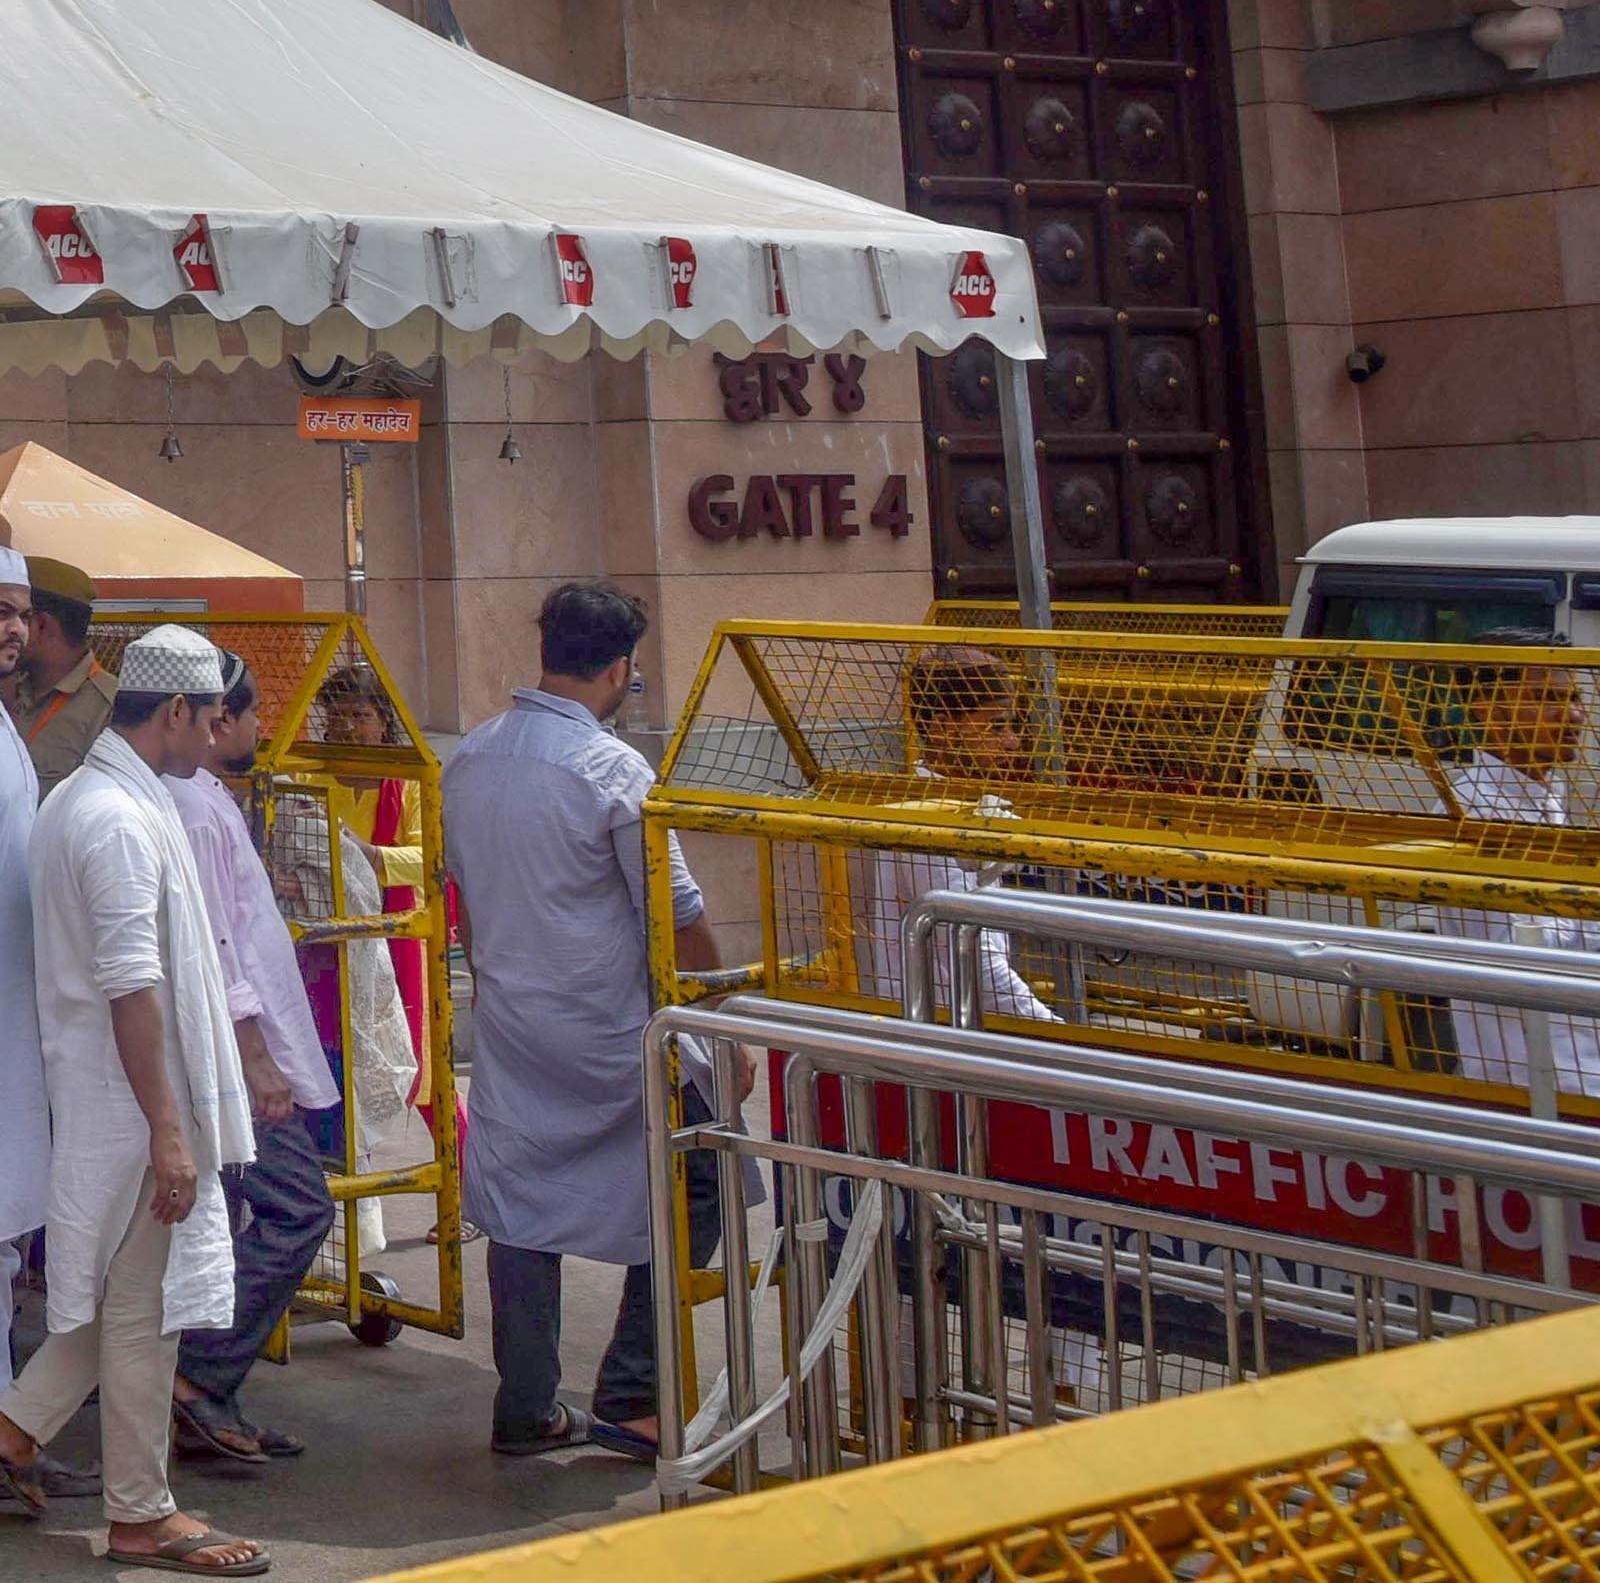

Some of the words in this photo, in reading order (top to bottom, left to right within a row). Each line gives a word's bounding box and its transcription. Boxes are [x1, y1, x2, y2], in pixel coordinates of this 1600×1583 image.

[951, 274, 991, 297] ACC
[362, 407, 414, 433] महादेव
[688, 473, 862, 541] GATE
[870, 474, 915, 538] 4
[1040, 1105, 1388, 1218] TRAFFIC
